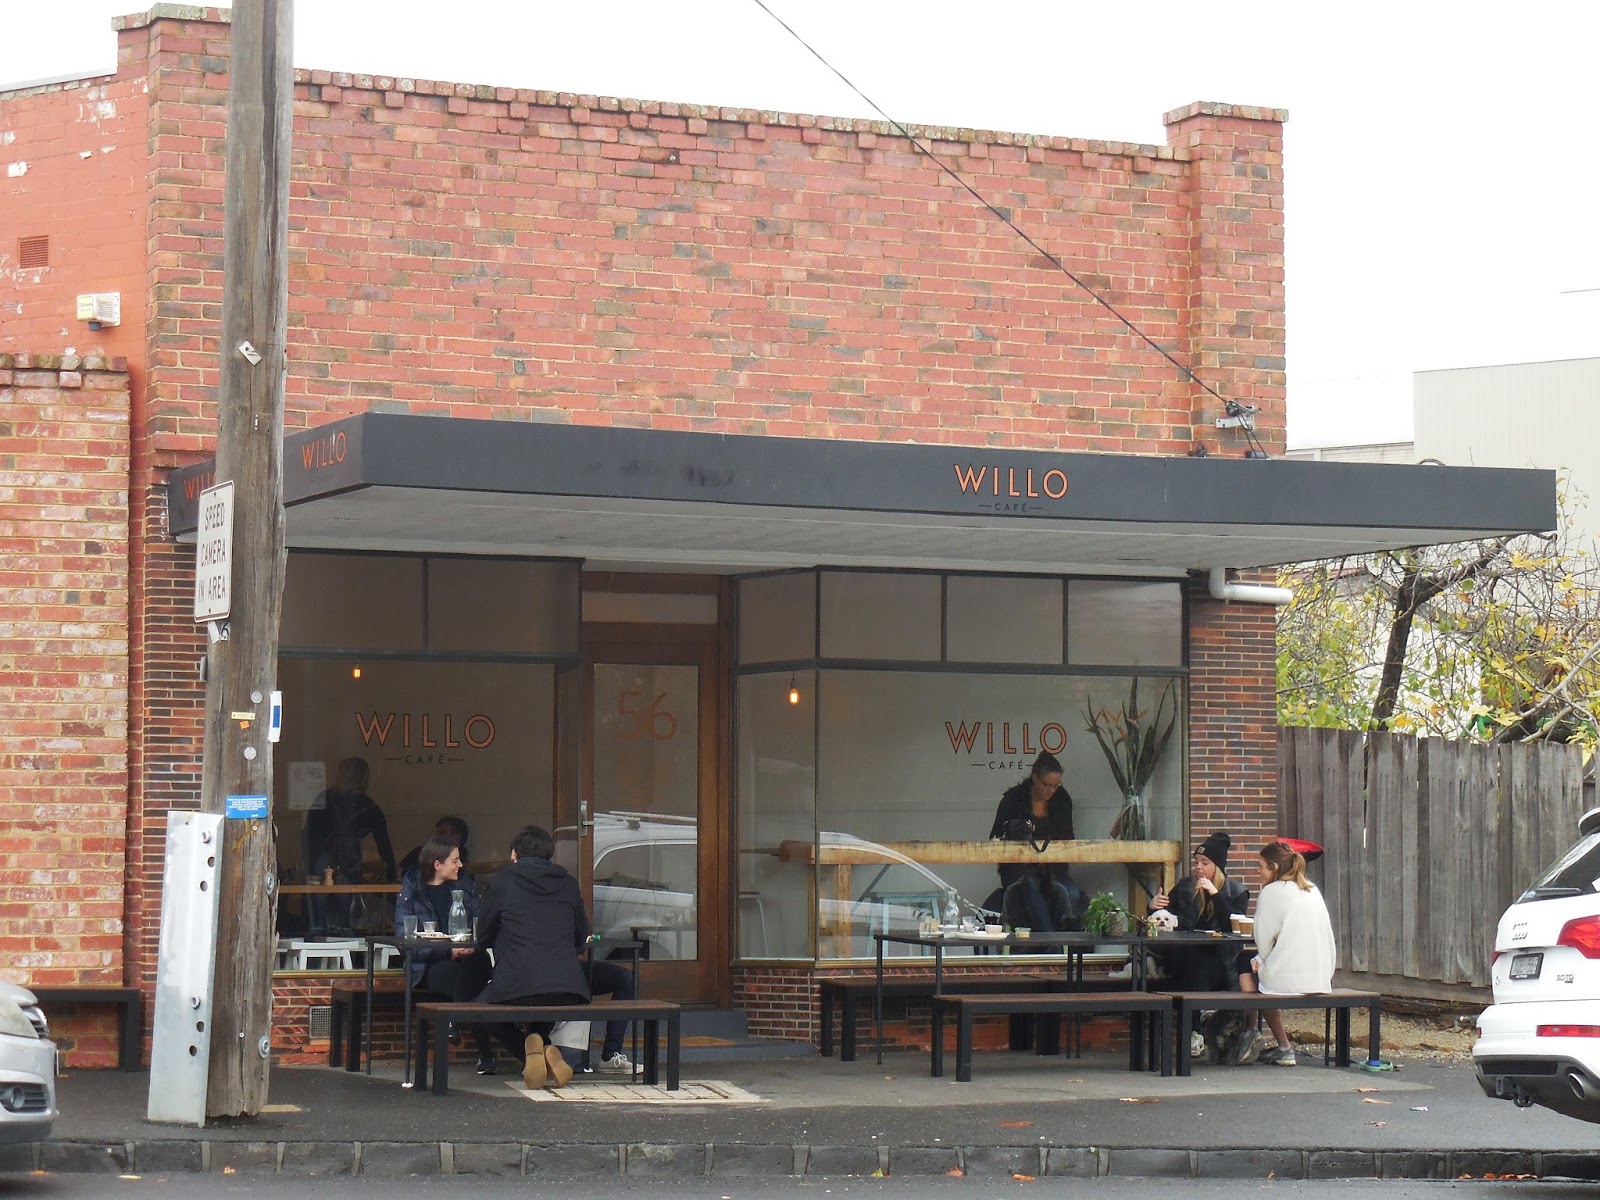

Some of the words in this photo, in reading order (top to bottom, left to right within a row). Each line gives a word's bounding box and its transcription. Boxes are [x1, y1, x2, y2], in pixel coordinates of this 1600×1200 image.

[302, 431, 346, 470] WILLO
[954, 463, 1068, 499] WILLO
[205, 502, 225, 531] SPEED
[201, 538, 226, 567] CAMERA
[198, 578, 205, 603] IN
[208, 574, 226, 600] AREA
[354, 711, 496, 749] WILLO
[618, 690, 677, 740] 56
[944, 720, 1067, 755] WILLO
